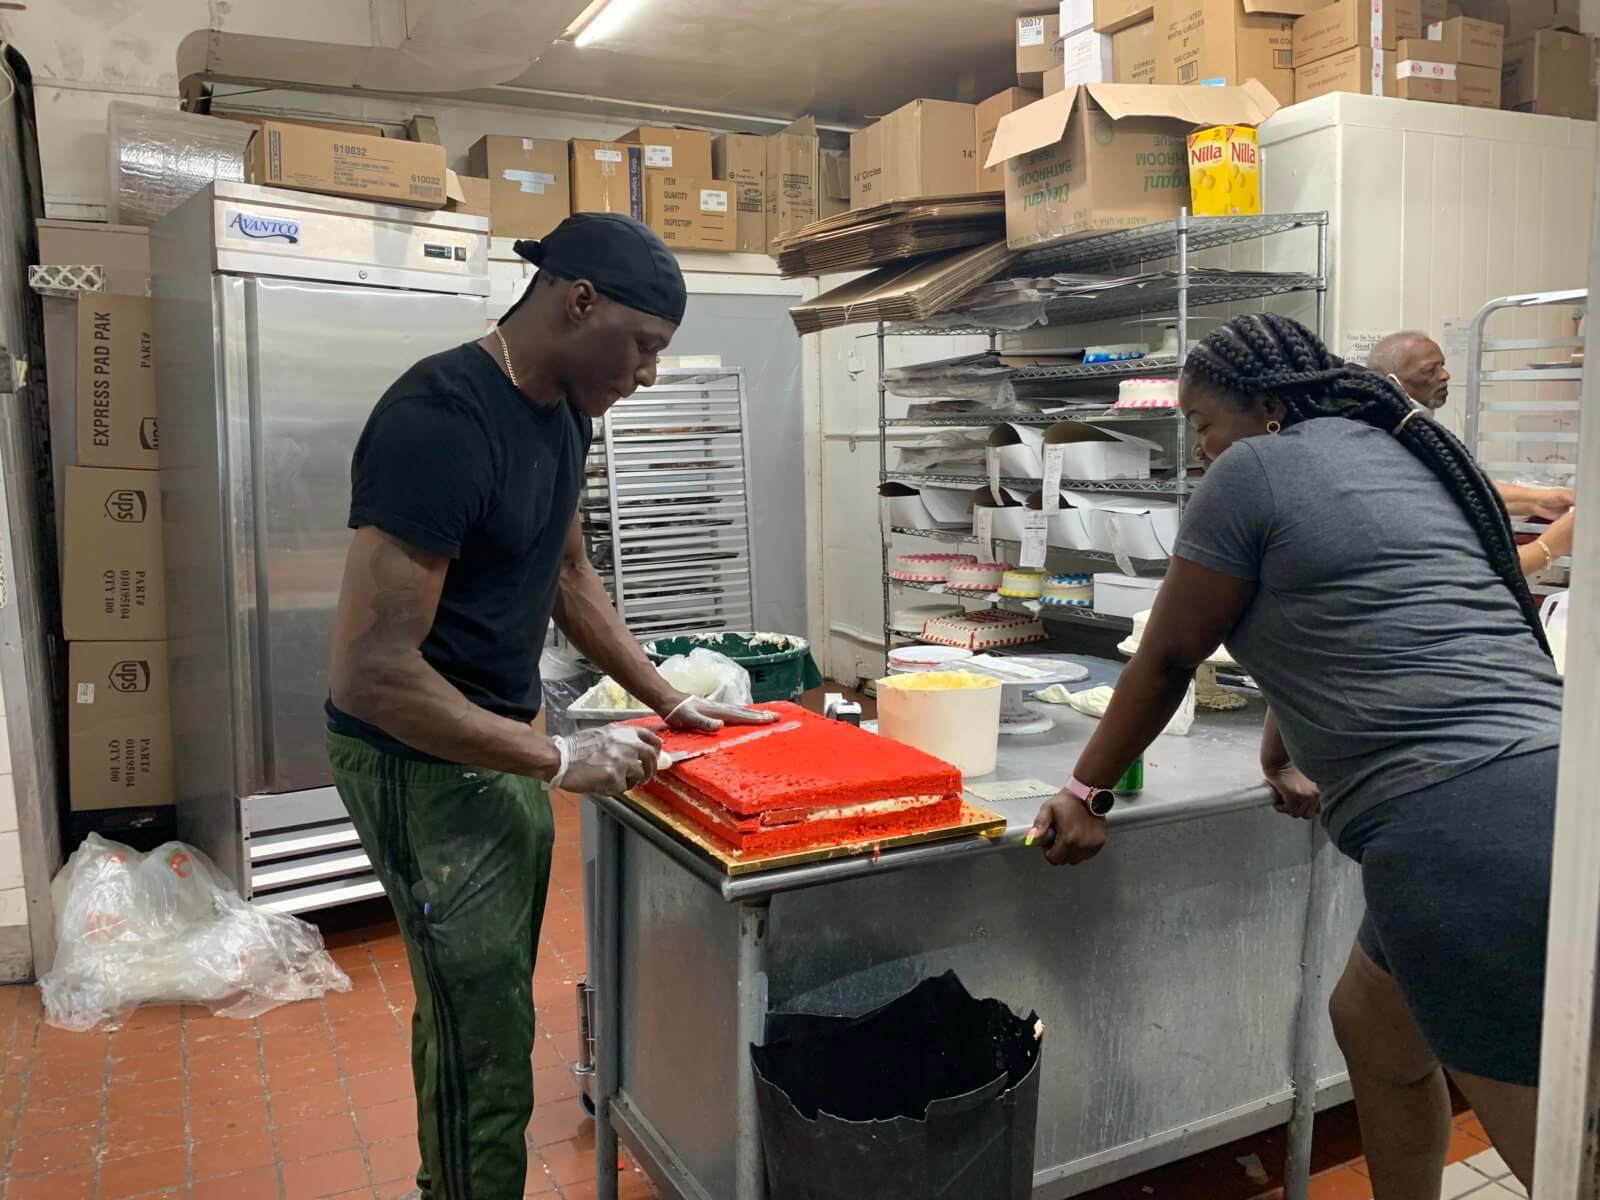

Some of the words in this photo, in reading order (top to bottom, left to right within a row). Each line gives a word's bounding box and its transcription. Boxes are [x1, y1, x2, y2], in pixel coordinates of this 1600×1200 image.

[1191, 145, 1222, 165] Nilla
[1231, 143, 1256, 165] Nilla
[411, 174, 441, 185] 610032
[1017, 160, 1072, 188] BATHROOM
[94, 311, 111, 341] PAK
[94, 346, 111, 375] PAD
[93, 380, 111, 447] EXPRESS
[112, 492, 134, 520] ups
[103, 570, 116, 592] QTY
[135, 570, 146, 606] PART#
[104, 597, 115, 614] 100
[115, 663, 138, 690] ups
[108, 739, 121, 762] QTY
[140, 738, 150, 773] PART#
[110, 767, 121, 782] 100
